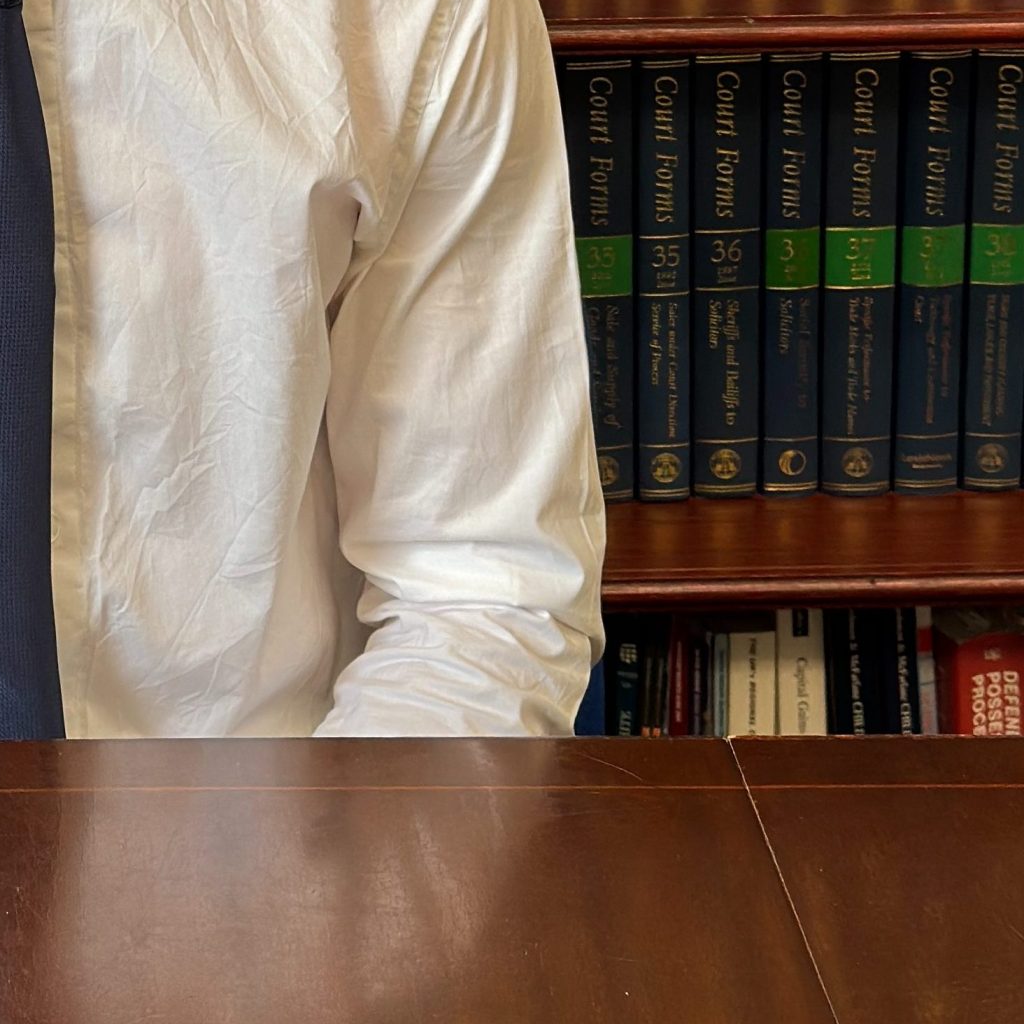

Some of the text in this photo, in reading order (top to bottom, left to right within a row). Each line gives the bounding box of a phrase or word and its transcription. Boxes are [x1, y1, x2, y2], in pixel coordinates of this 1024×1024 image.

[716, 71, 740, 217] Court Forms
[652, 245, 680, 267] 35
[711, 239, 742, 263] 36
